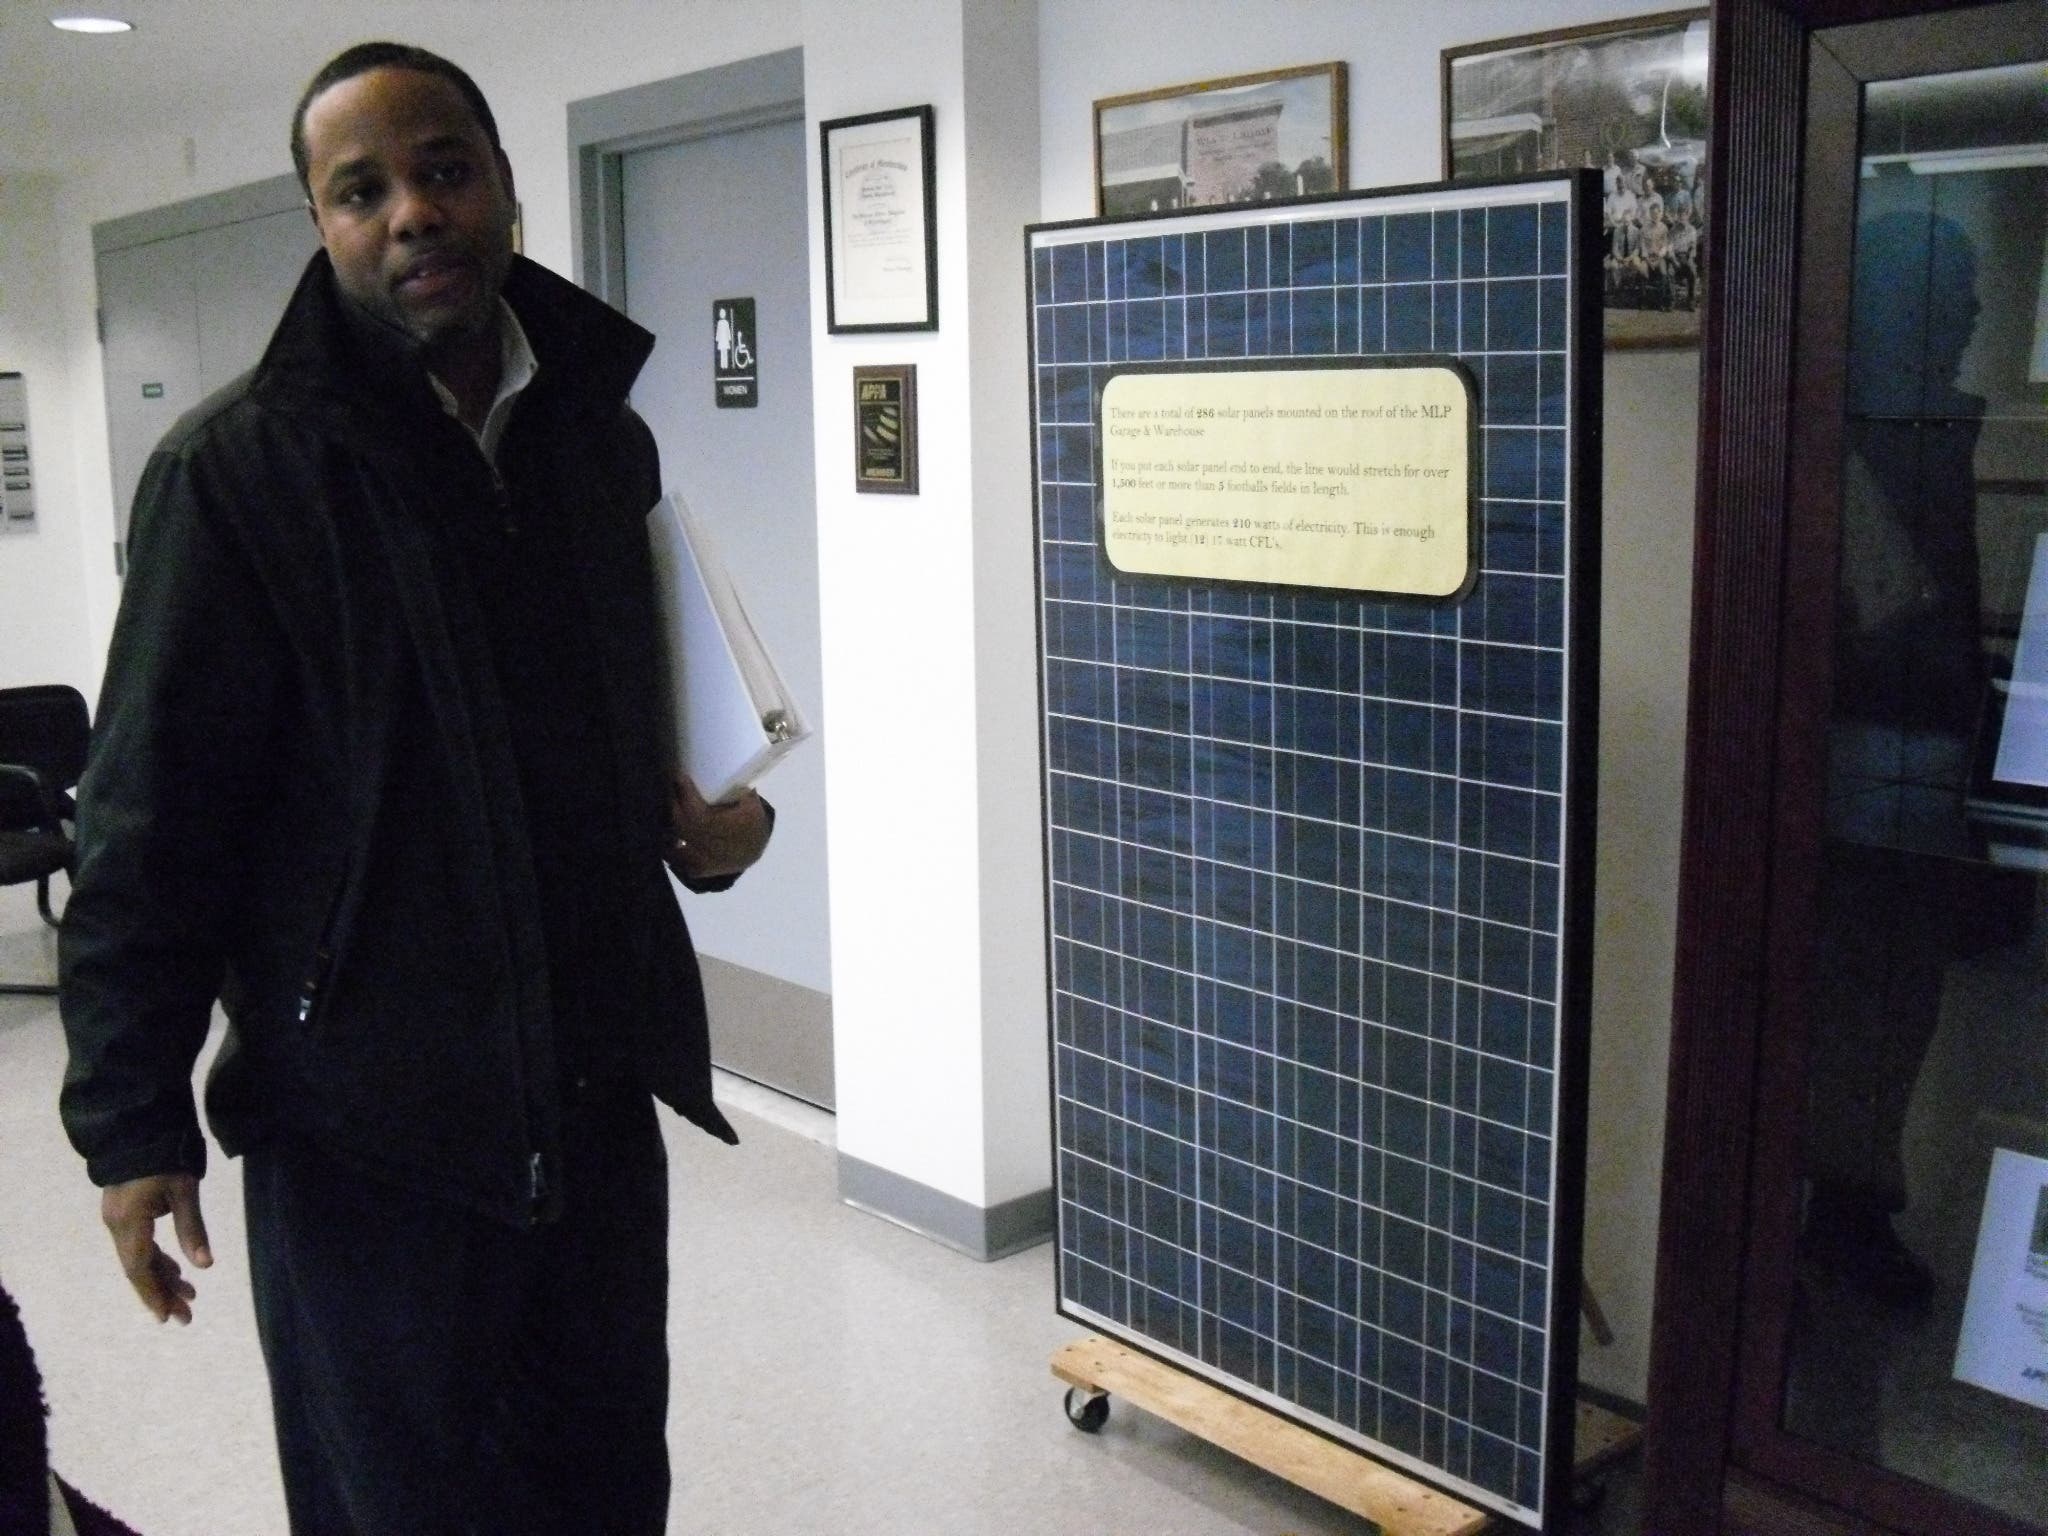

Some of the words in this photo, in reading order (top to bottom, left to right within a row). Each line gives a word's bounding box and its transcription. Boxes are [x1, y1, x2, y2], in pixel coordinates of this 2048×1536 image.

[1111, 407, 1135, 419] There
[1138, 411, 1151, 419] are
[1161, 407, 1181, 419] total
[1184, 406, 1194, 419] of
[1218, 406, 1240, 419] solar
[1243, 406, 1273, 423] panels
[1277, 406, 1321, 419] mounted
[1325, 410, 1338, 419] on
[1341, 406, 1358, 419] the
[1361, 406, 1383, 419] roof
[1386, 405, 1398, 419] of
[1400, 406, 1418, 419] the
[1421, 405, 1452, 419] MLP
[1110, 425, 1141, 439] Garage
[1144, 425, 1152, 436] &
[1111, 459, 1118, 471] If
[1120, 462, 1136, 474] you
[1138, 461, 1152, 474] put
[1154, 460, 1174, 472] each
[1177, 460, 1199, 473] solar
[1202, 459, 1227, 476] panel
[1230, 460, 1247, 473] end
[1250, 463, 1260, 473] to
[1286, 462, 1302, 475] the
[1305, 462, 1324, 475] line
[1328, 463, 1360, 476] would
[1363, 464, 1401, 478] stretch
[1404, 464, 1420, 478] for
[1424, 469, 1450, 479] over
[1112, 478, 1136, 490] 1,500
[1138, 478, 1154, 489] feet
[1156, 481, 1166, 490] or
[1169, 481, 1191, 491] more
[1195, 479, 1215, 491] than
[1218, 481, 1225, 492] 5
[1271, 480, 1297, 494] fields
[1301, 482, 1310, 494] in
[1313, 482, 1349, 499] length.
[1112, 511, 1133, 523] Each
[1136, 512, 1155, 524] solar
[1158, 512, 1183, 529] panel
[1186, 515, 1230, 529] generates
[1232, 517, 1251, 529] 210
[1254, 518, 1281, 530] watts
[1283, 518, 1294, 530] of
[1354, 521, 1379, 535] This
[1382, 522, 1390, 536] is
[1393, 524, 1436, 542] enough
[1154, 532, 1164, 542] to
[1166, 531, 1187, 547] light
